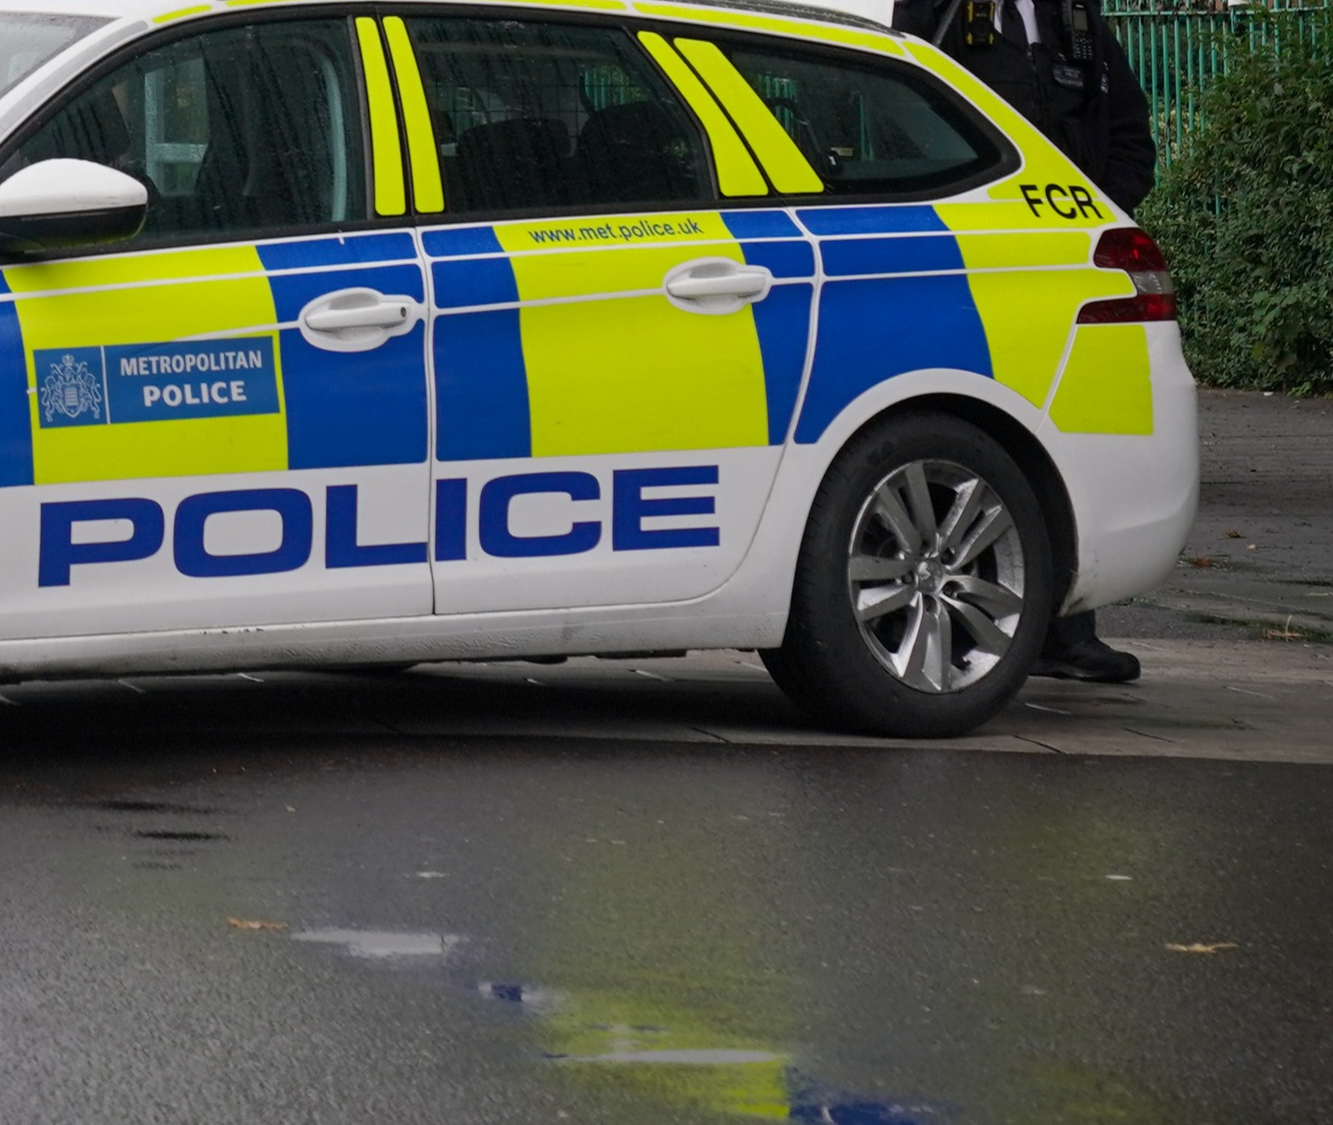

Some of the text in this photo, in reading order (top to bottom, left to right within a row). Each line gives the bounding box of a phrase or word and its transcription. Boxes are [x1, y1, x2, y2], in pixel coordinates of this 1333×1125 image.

[1020, 183, 1104, 220] FCR
[528, 218, 703, 243] www.met.police.uk
[120, 350, 263, 376] METROPOLITAN
[143, 380, 247, 407] POLICE
[37, 464, 721, 588] POLICE
